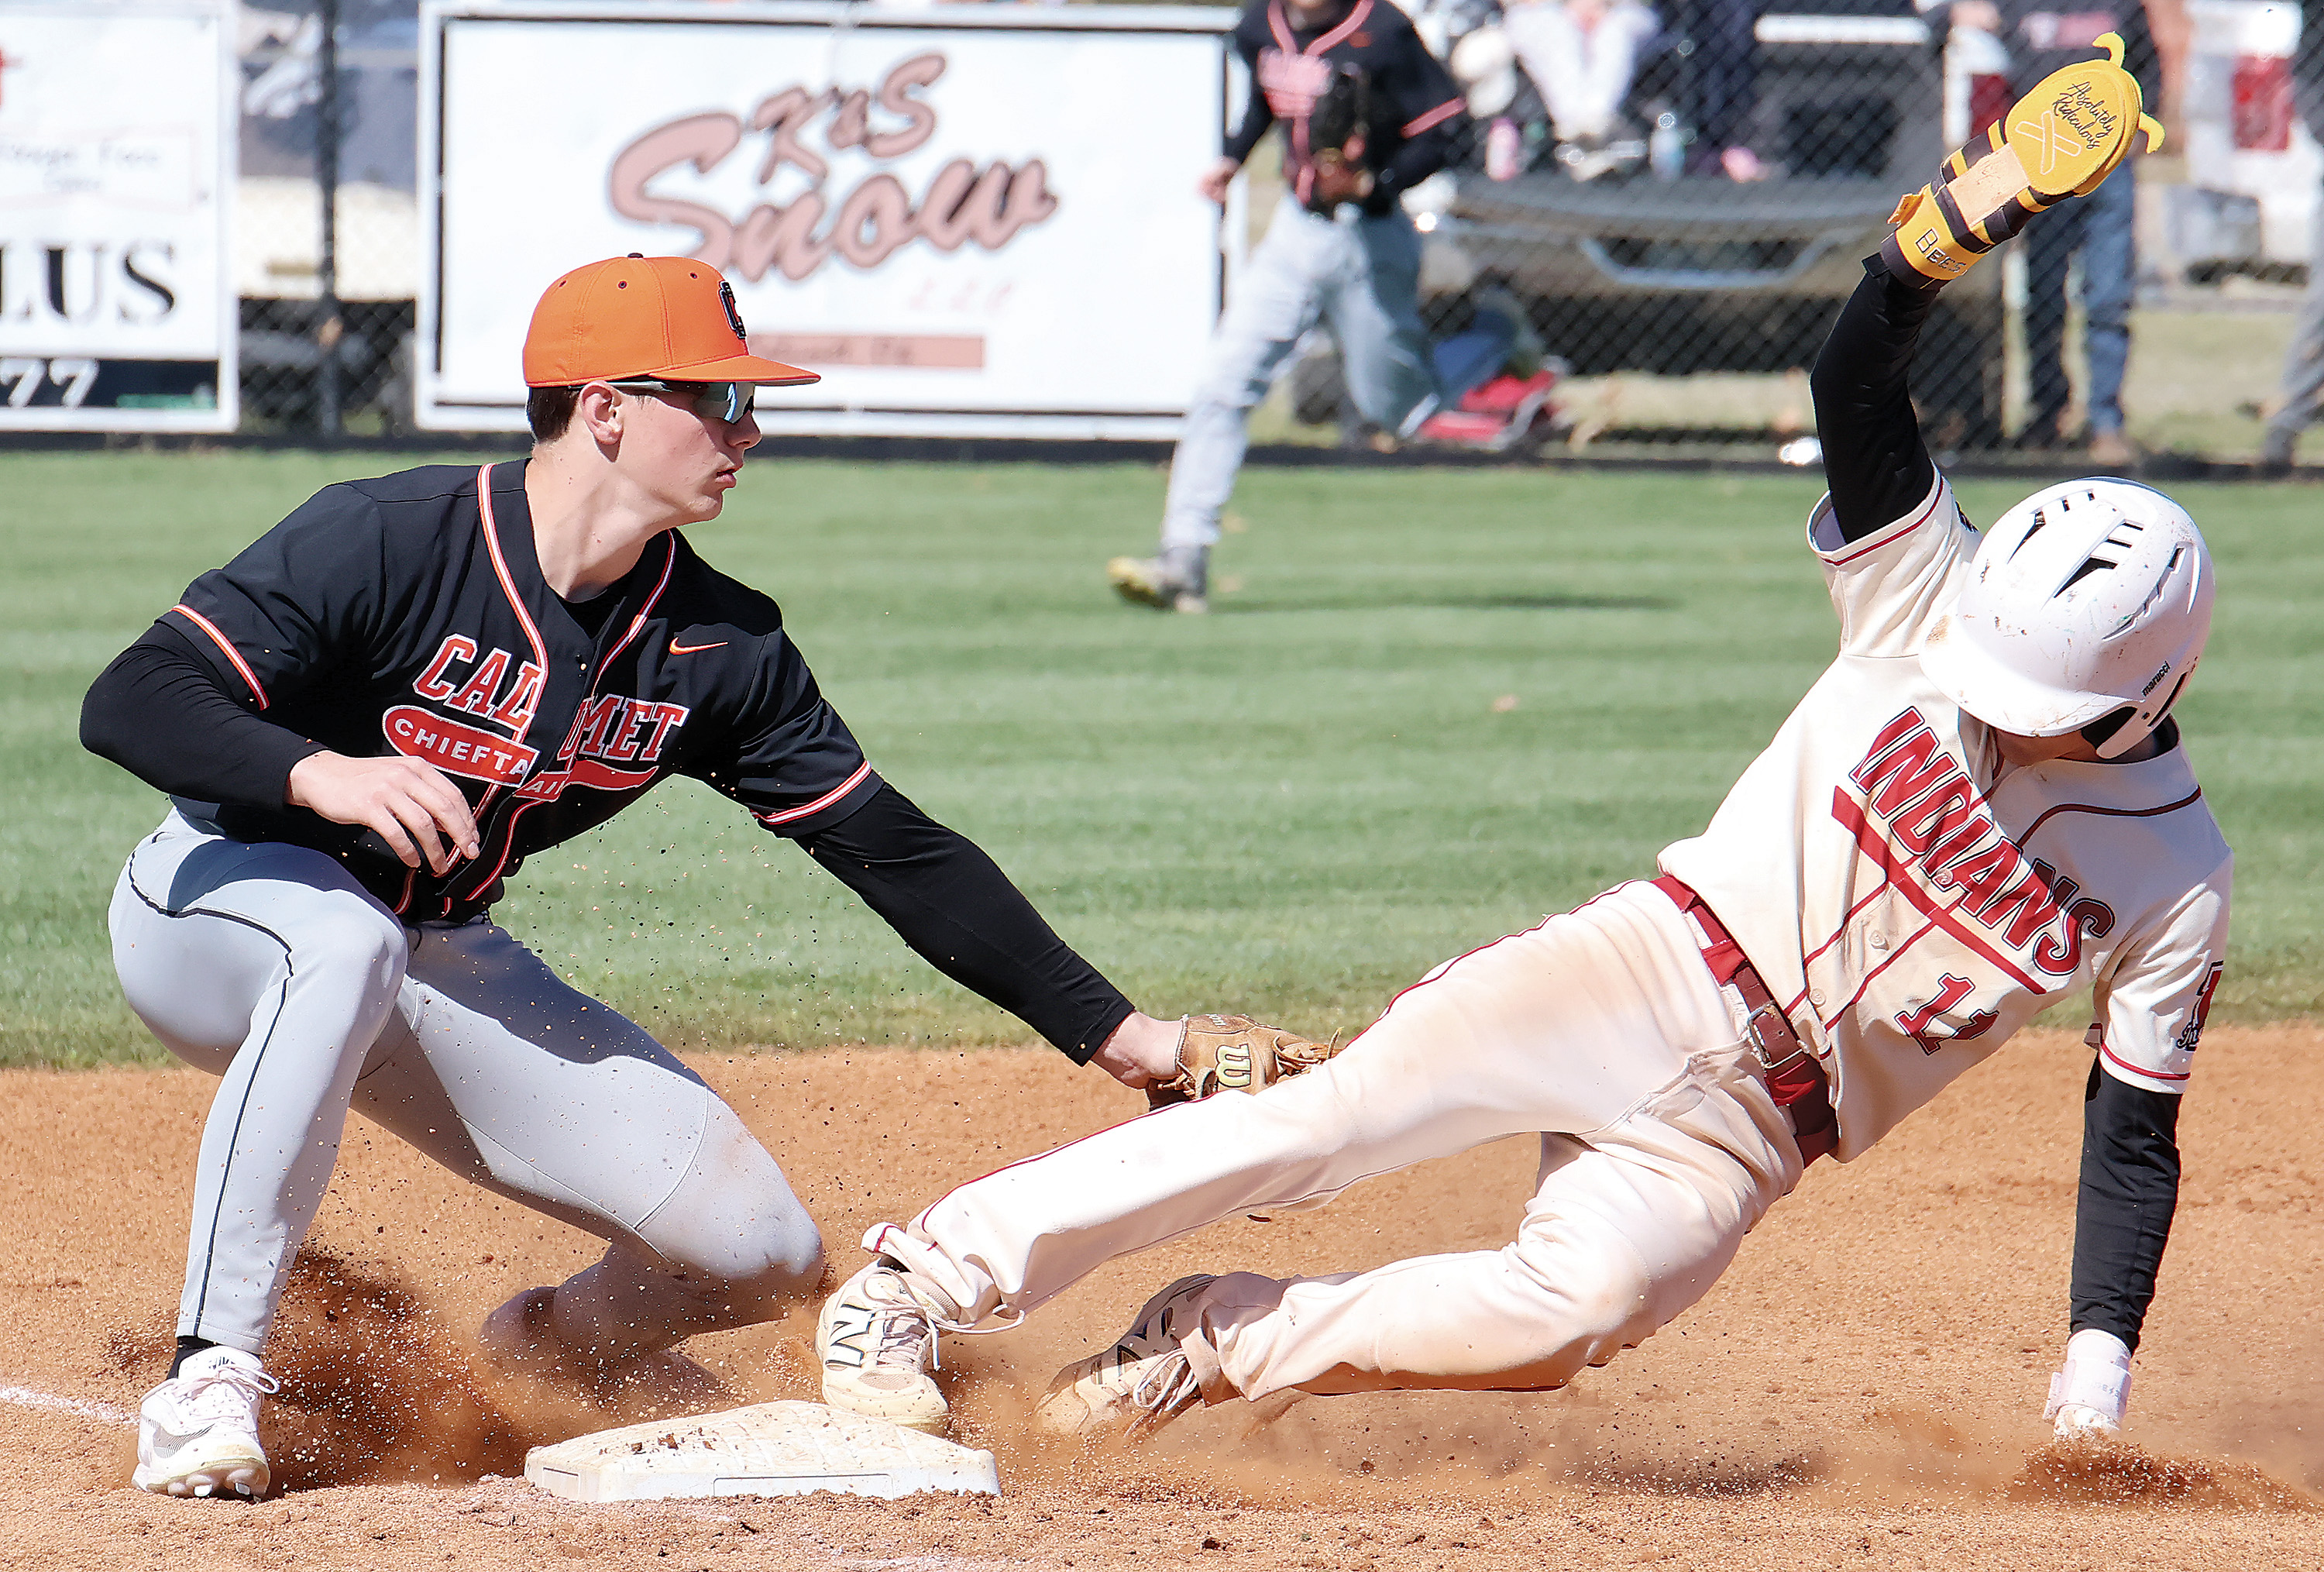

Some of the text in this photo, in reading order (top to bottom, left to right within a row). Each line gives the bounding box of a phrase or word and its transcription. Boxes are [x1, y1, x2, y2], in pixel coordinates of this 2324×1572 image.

[2052, 92, 2101, 150] Ridiculous
[2066, 81, 2117, 138] Absolutely
[609, 113, 1058, 281] Snow
[0, 358, 99, 408] 77
[2142, 659, 2171, 697] marucci
[1848, 705, 2116, 976] INDIANS
